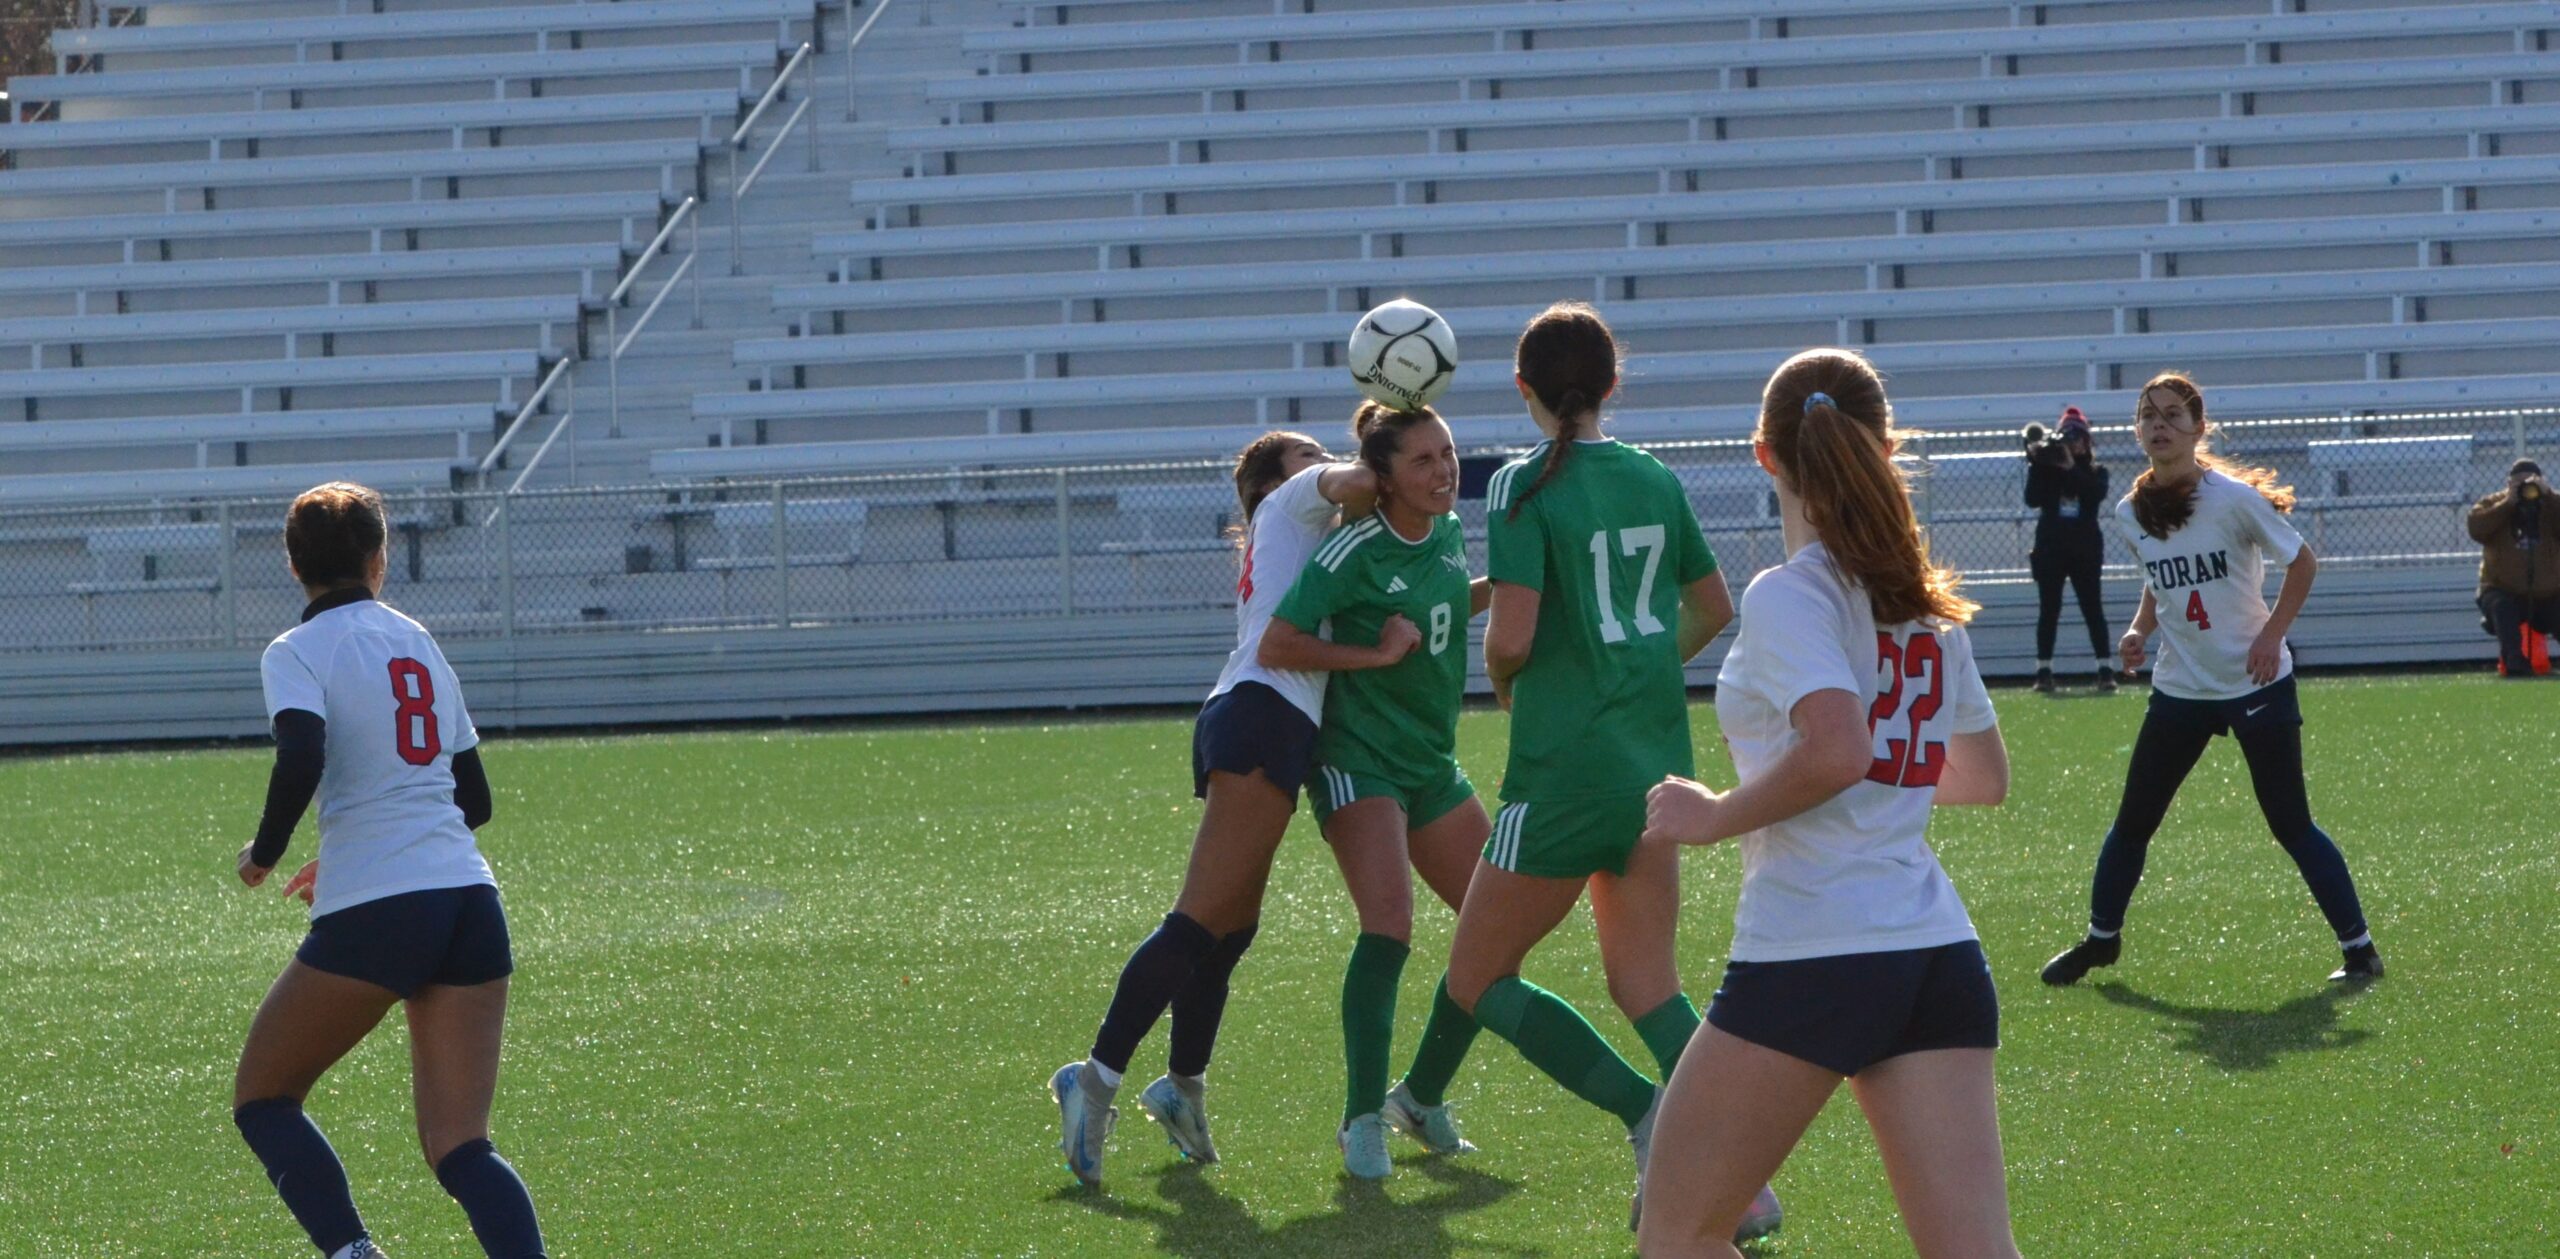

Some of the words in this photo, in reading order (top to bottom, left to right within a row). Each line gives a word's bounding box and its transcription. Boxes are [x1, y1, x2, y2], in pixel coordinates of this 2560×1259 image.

[1367, 361, 1426, 403] SPALDING
[1589, 523, 1666, 643] 17
[2145, 549, 2229, 591] FORAN
[1429, 602, 1452, 656] 8
[2185, 589, 2212, 631] 4
[387, 656, 442, 766] 8
[1865, 631, 1947, 788] 22
